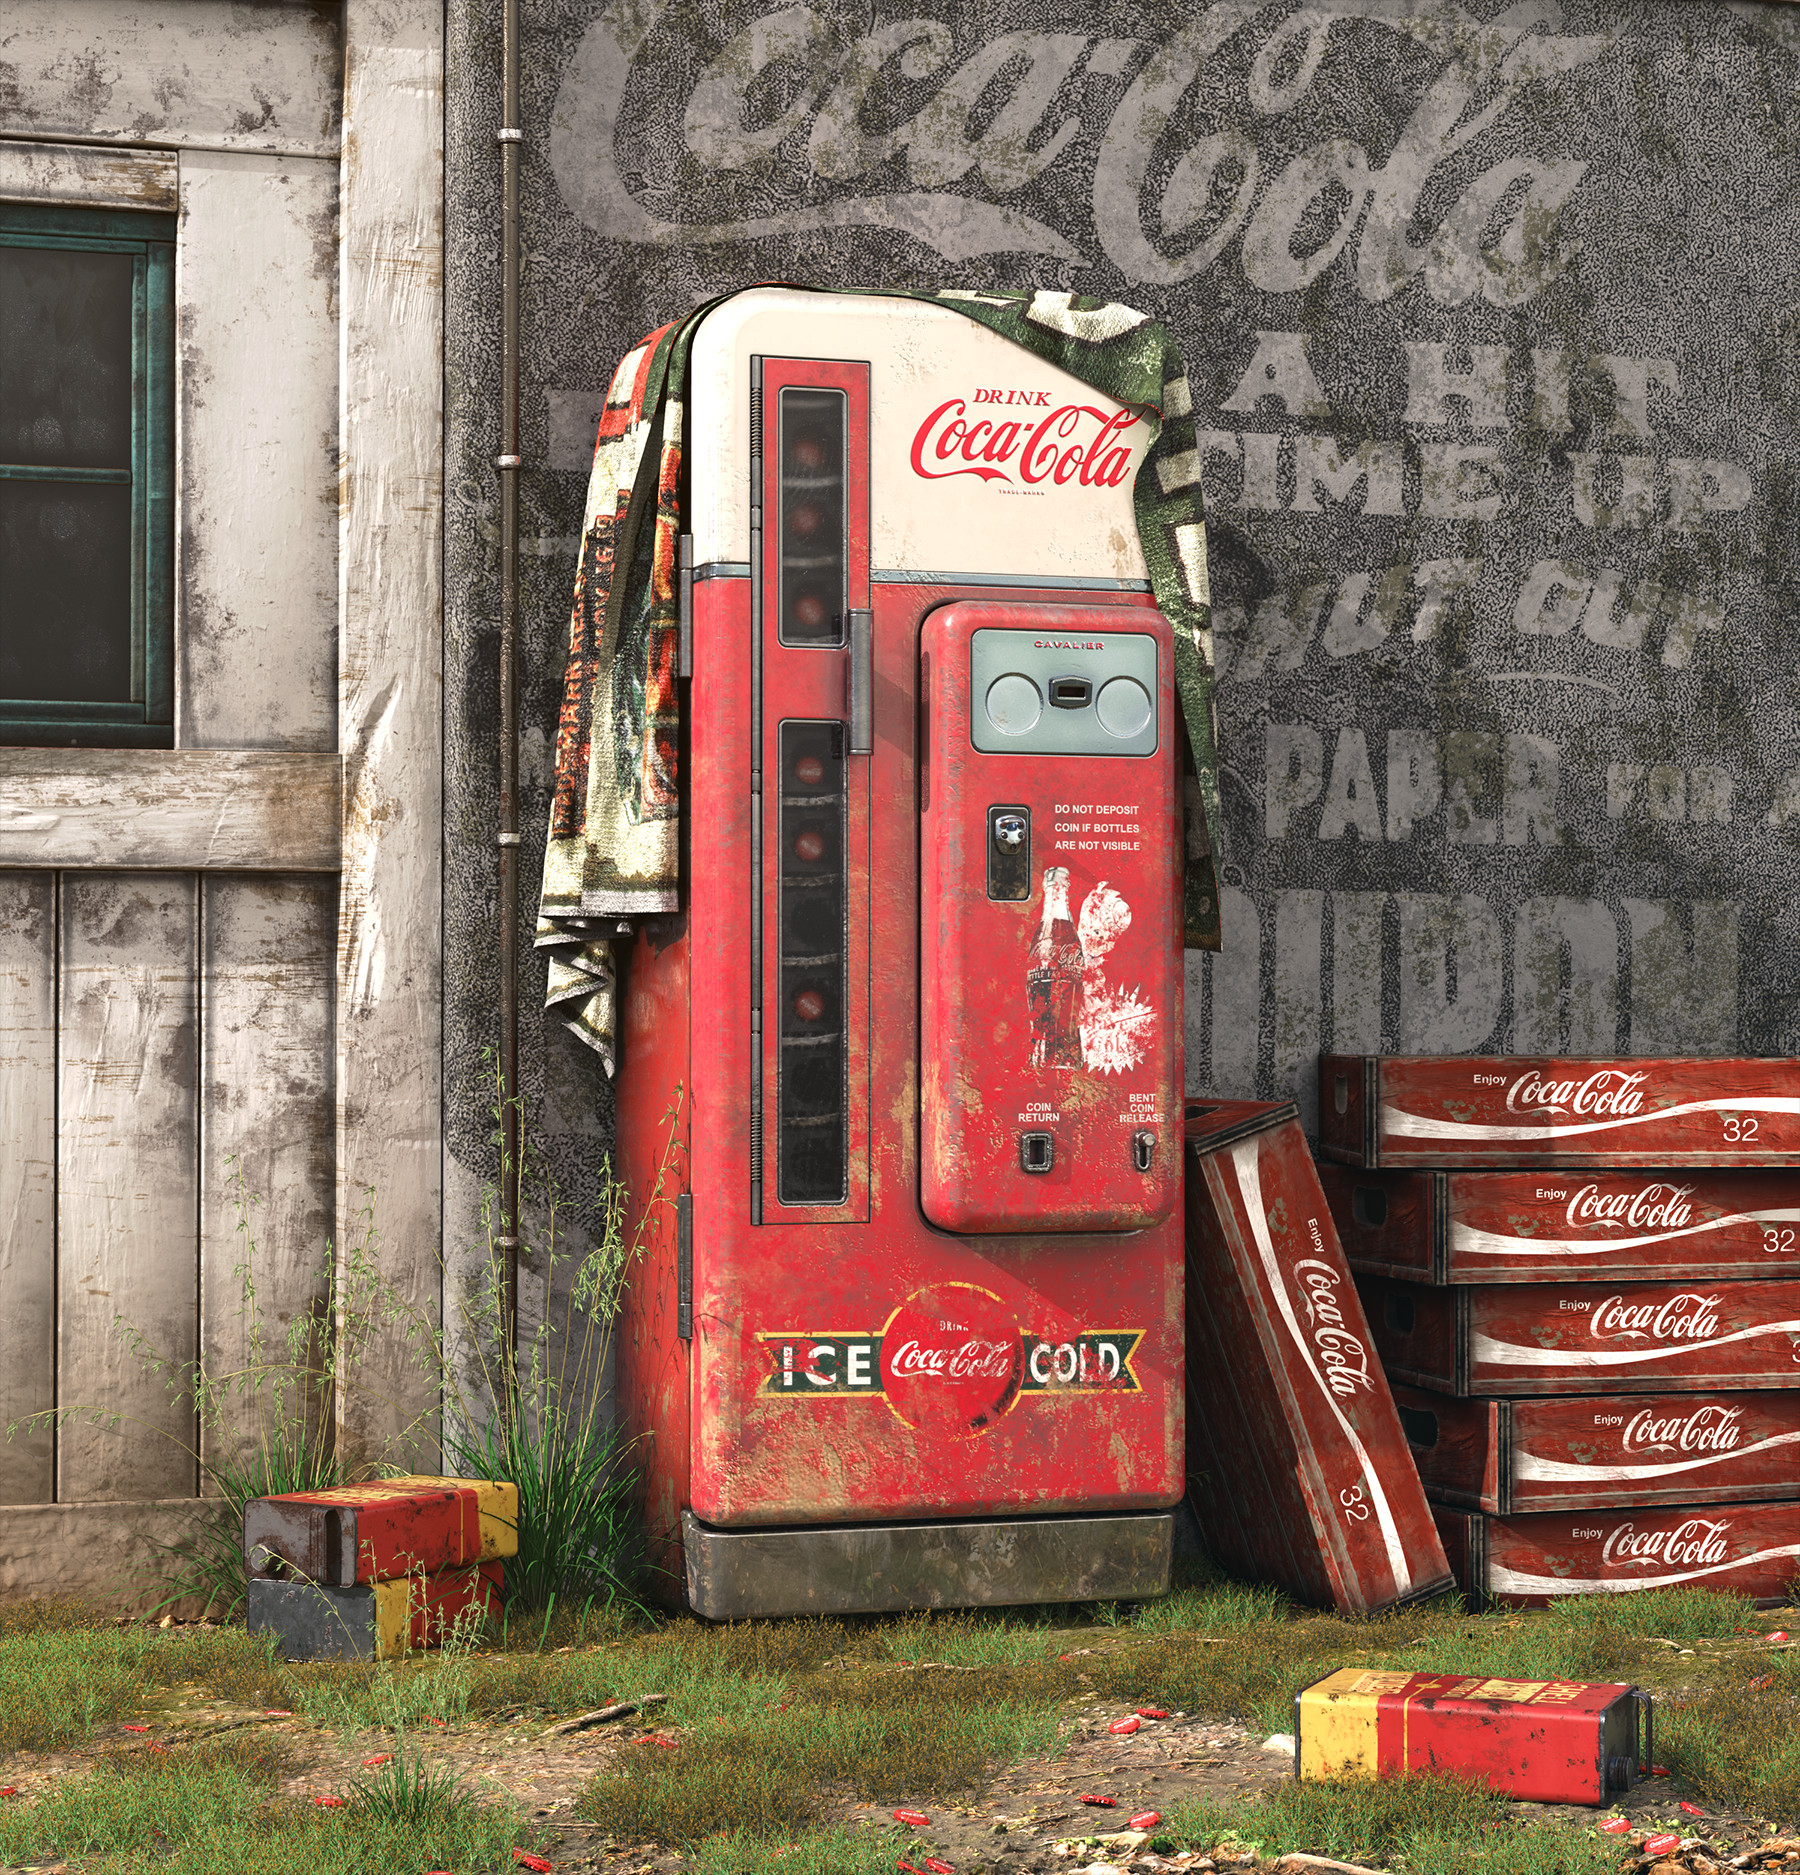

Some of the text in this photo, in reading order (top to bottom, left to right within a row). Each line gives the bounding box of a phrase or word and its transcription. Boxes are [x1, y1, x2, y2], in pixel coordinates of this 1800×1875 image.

[1220, 331, 1332, 417] A
[973, 387, 1052, 407] DRINK
[910, 398, 1147, 488] Coca-Cola
[1034, 640, 1105, 650] CAVALIER
[1055, 804, 1139, 815] DO NOT DEPOSIT
[1055, 822, 1140, 833] COIN IF BOTTLES
[1055, 840, 1140, 851] ARE NOT VISIBLE
[1129, 1093, 1156, 1103] BENT
[1473, 1070, 1652, 1116] Enjoy Coca-Cola
[1018, 1112, 1060, 1123] RETURN
[1026, 1103, 1051, 1112] COIN
[1119, 1113, 1165, 1123] RELEASE
[1129, 1103, 1155, 1113] COIN
[1722, 1118, 1760, 1142] 32
[1535, 1183, 1698, 1229] Enjoy Coca-Cola
[1763, 1229, 1797, 1253] 32
[1293, 1217, 1377, 1398] Enjoy Coca-Cola
[1559, 1293, 1727, 1340] Enjoy Coca-Cola
[782, 1344, 872, 1387] ICE
[1030, 1342, 1121, 1384] COLD
[1594, 1405, 1747, 1453] Enjoy Coca-Cola
[1339, 1484, 1369, 1526] 32
[1572, 1519, 1734, 1568] Enjoy Coca-Cola
